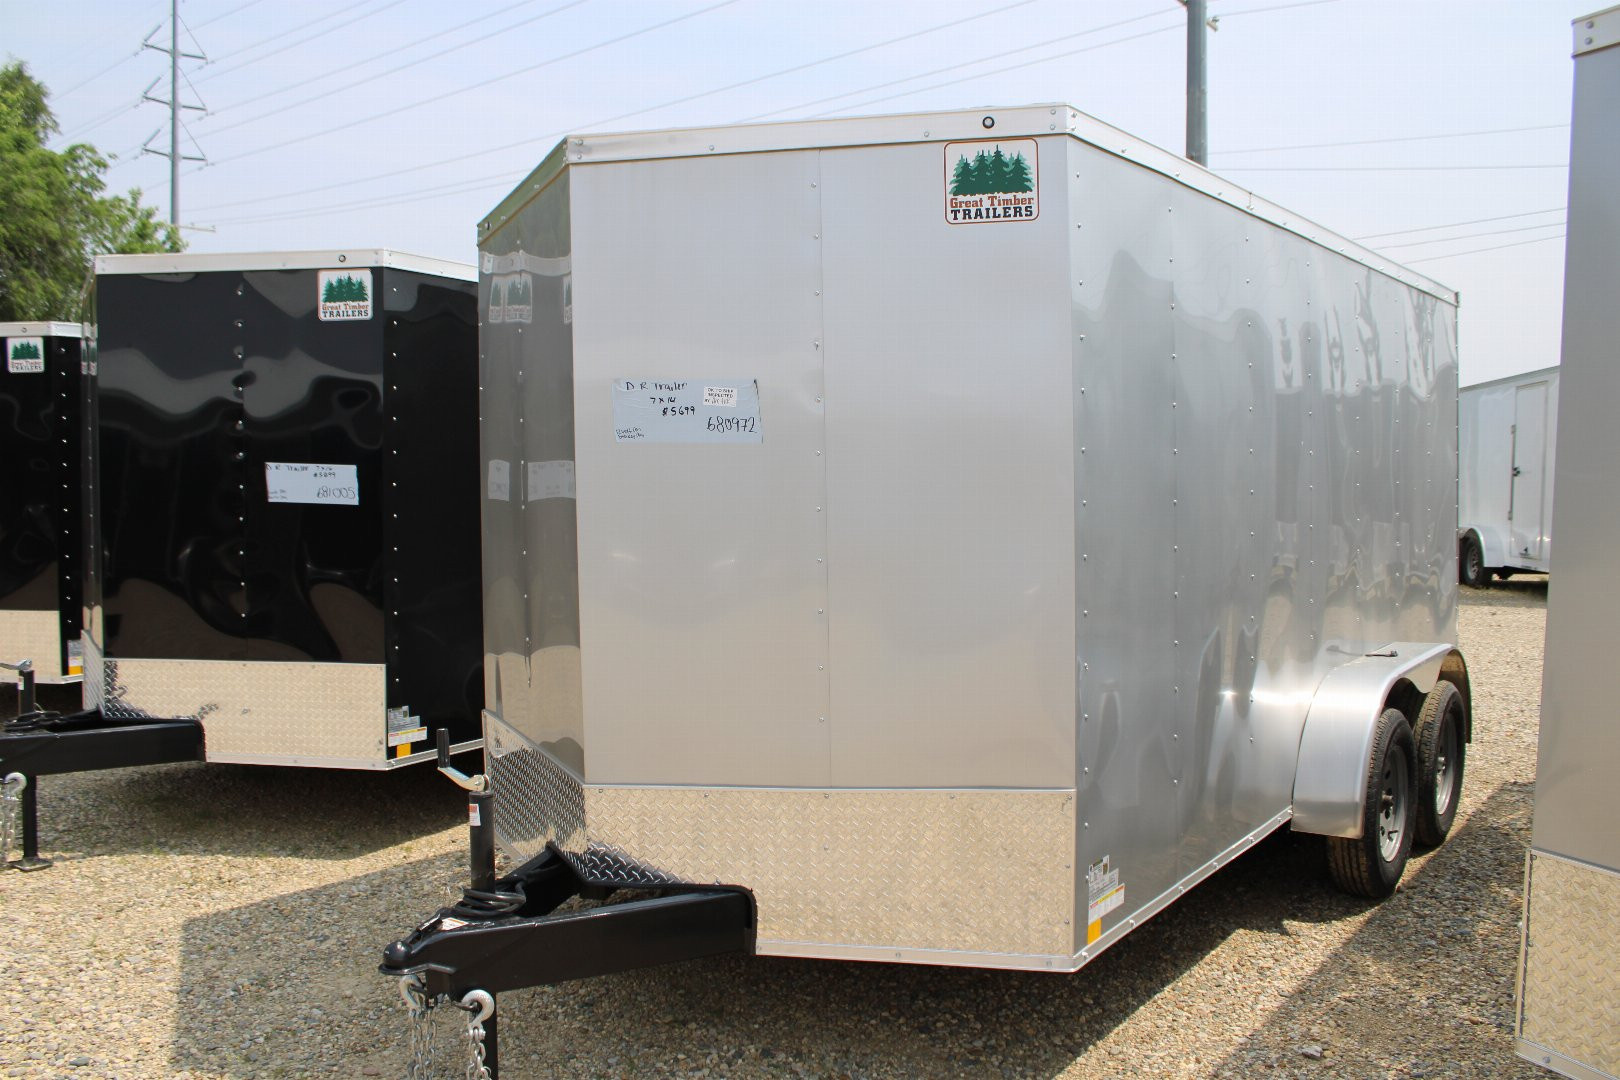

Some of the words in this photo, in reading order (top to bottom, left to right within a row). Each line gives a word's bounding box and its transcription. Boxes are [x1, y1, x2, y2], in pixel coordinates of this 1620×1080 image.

[950, 197, 983, 209] Great
[987, 194, 1035, 207] Timber
[950, 205, 1034, 220] TRAILERS
[321, 309, 369, 318] TRAILERS
[661, 405, 696, 417] $5699
